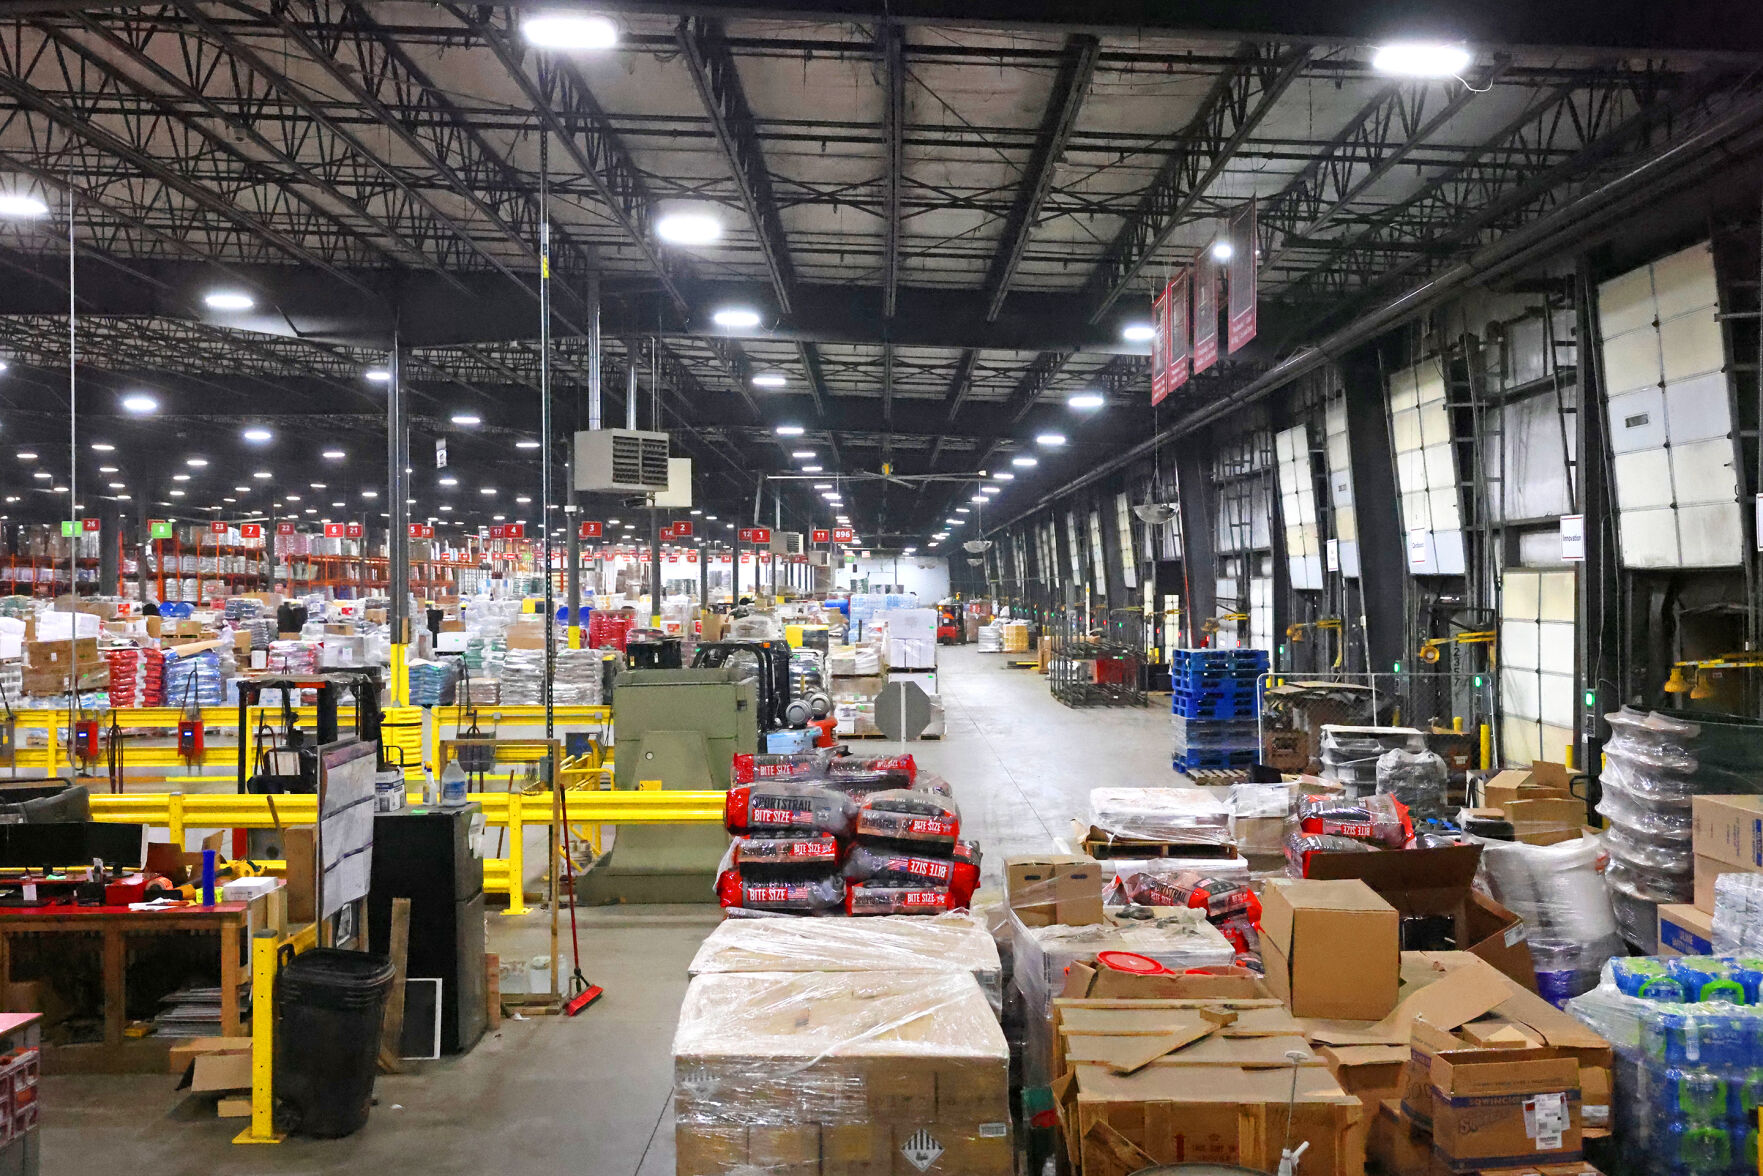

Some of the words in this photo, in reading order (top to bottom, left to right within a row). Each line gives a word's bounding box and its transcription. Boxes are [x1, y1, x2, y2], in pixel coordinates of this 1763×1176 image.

[247, 526, 254, 534] 7
[511, 526, 516, 534] 4
[589, 524, 595, 532] 3
[758, 531, 763, 539] 1
[835, 530, 851, 538] 896
[760, 765, 775, 776] BITE
[776, 764, 791, 775] SIZE
[752, 796, 813, 812] SPORTSTRAIL
[754, 809, 771, 822] BITE
[772, 810, 790, 823] SIZE
[913, 820, 927, 831] BITE
[927, 819, 942, 831] SIZE
[1343, 825, 1356, 835] SIZE
[1357, 825, 1371, 836] BITE
[793, 843, 807, 854] BITE
[807, 842, 821, 853] SIZE
[910, 860, 928, 874] SIZE
[929, 864, 947, 878] BITE
[749, 889, 766, 901] BITE
[768, 888, 786, 901] SIZE
[907, 893, 920, 903] BITE
[921, 893, 935, 903] SIZE
